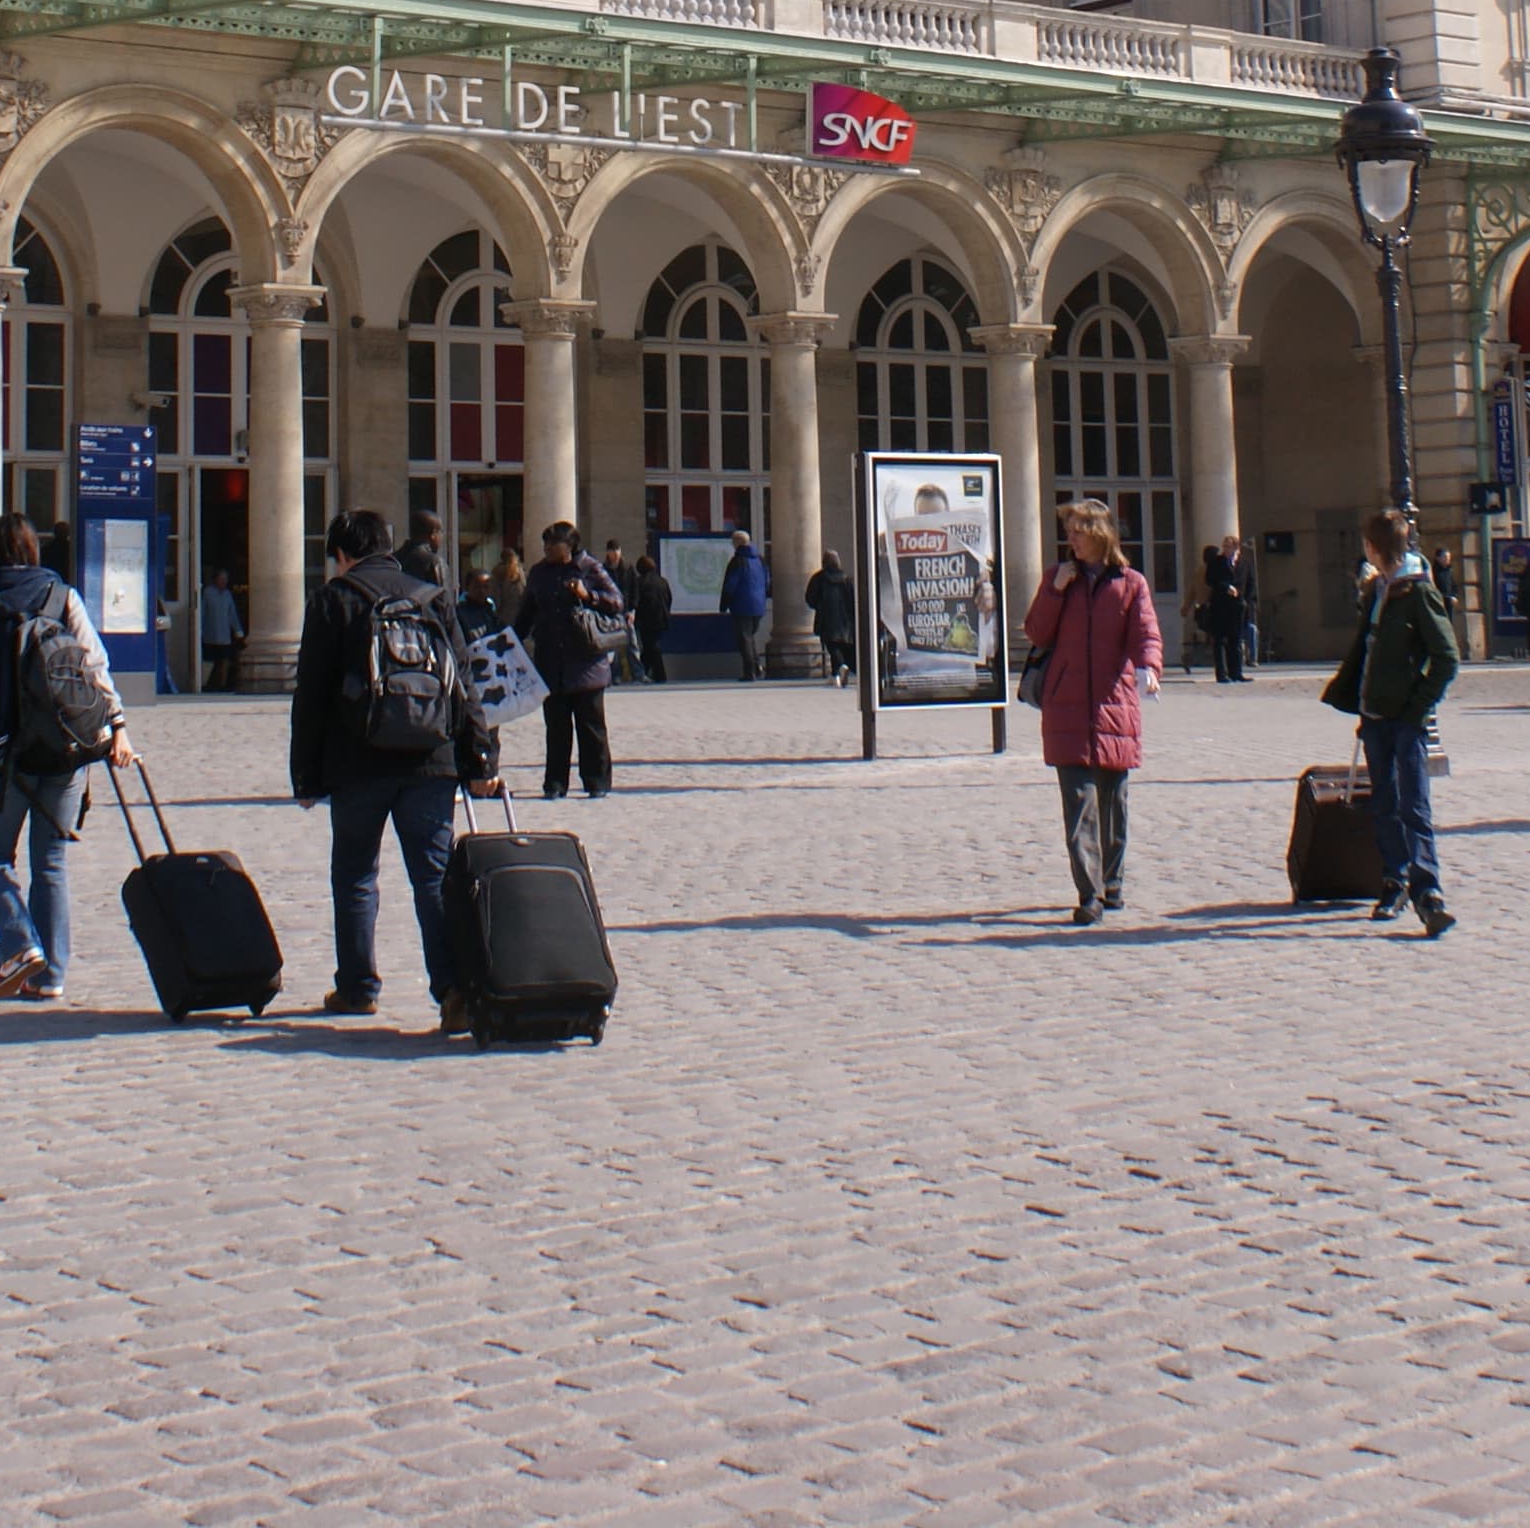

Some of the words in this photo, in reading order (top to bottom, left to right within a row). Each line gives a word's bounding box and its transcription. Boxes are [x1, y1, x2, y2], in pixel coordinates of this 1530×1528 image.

[326, 64, 484, 127] GARE
[516, 81, 581, 134] DE
[612, 89, 744, 148] L'EST
[818, 112, 913, 152] SNCF
[1498, 404, 1511, 464] HOTEL
[900, 532, 945, 552] Today
[915, 555, 966, 578] FRENCH
[906, 577, 975, 602] INVASION!
[907, 613, 950, 629] EUROSTAR
